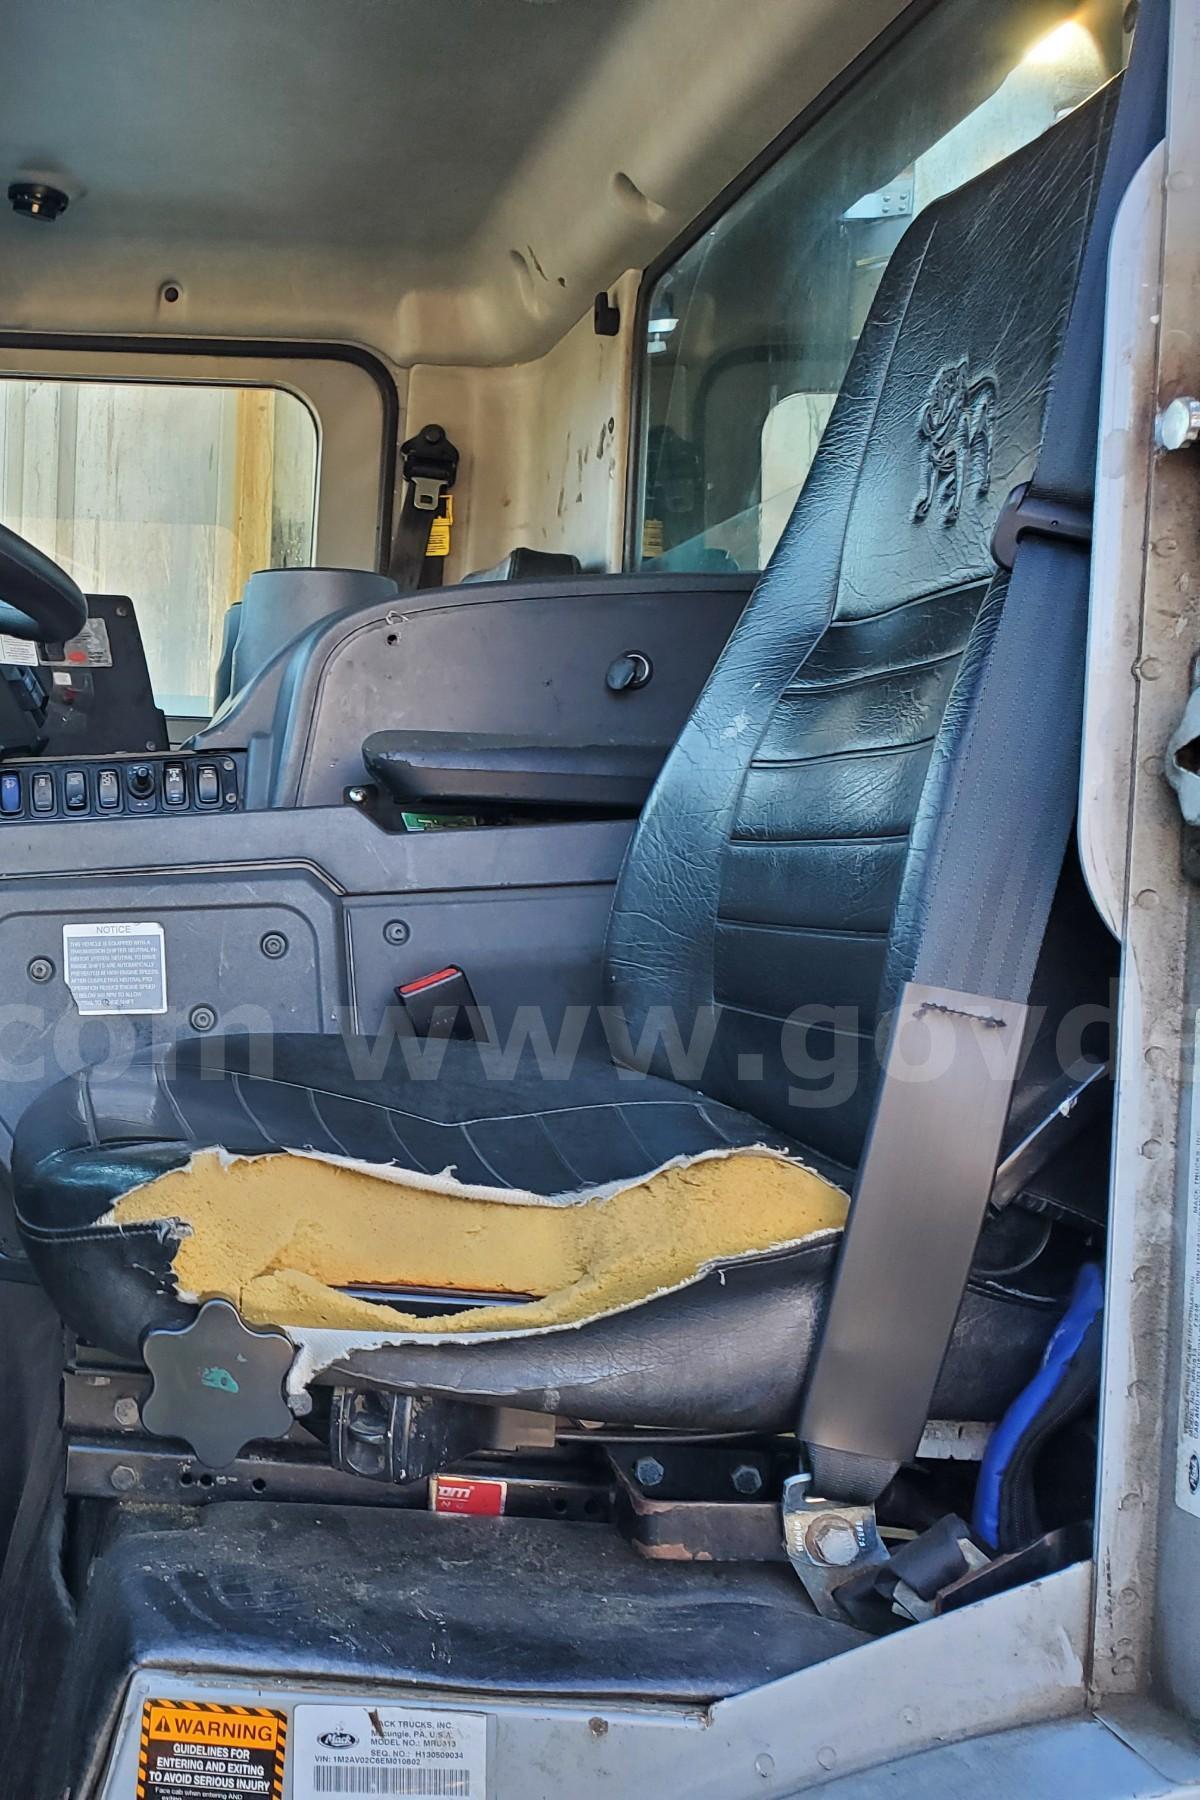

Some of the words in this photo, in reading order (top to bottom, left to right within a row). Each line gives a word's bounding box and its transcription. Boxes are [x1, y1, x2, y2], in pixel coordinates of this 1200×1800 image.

[96, 925, 131, 934] NOTICE
[174, 1718, 272, 1741] WARNING
[173, 1743, 230, 1757] GUIDELINES
[231, 1749, 250, 1759] FOR
[314, 1755, 331, 1763] VIN:
[156, 1756, 204, 1771] ENTERING
[205, 1762, 226, 1773] AND
[227, 1763, 265, 1776] EXITING
[149, 1771, 163, 1781] TO
[163, 1772, 193, 1784] AVOID
[193, 1775, 235, 1788] SERIOUS
[236, 1778, 271, 1791] INJURY
[184, 1789, 201, 1797] when
[202, 1791, 227, 1800] entering
